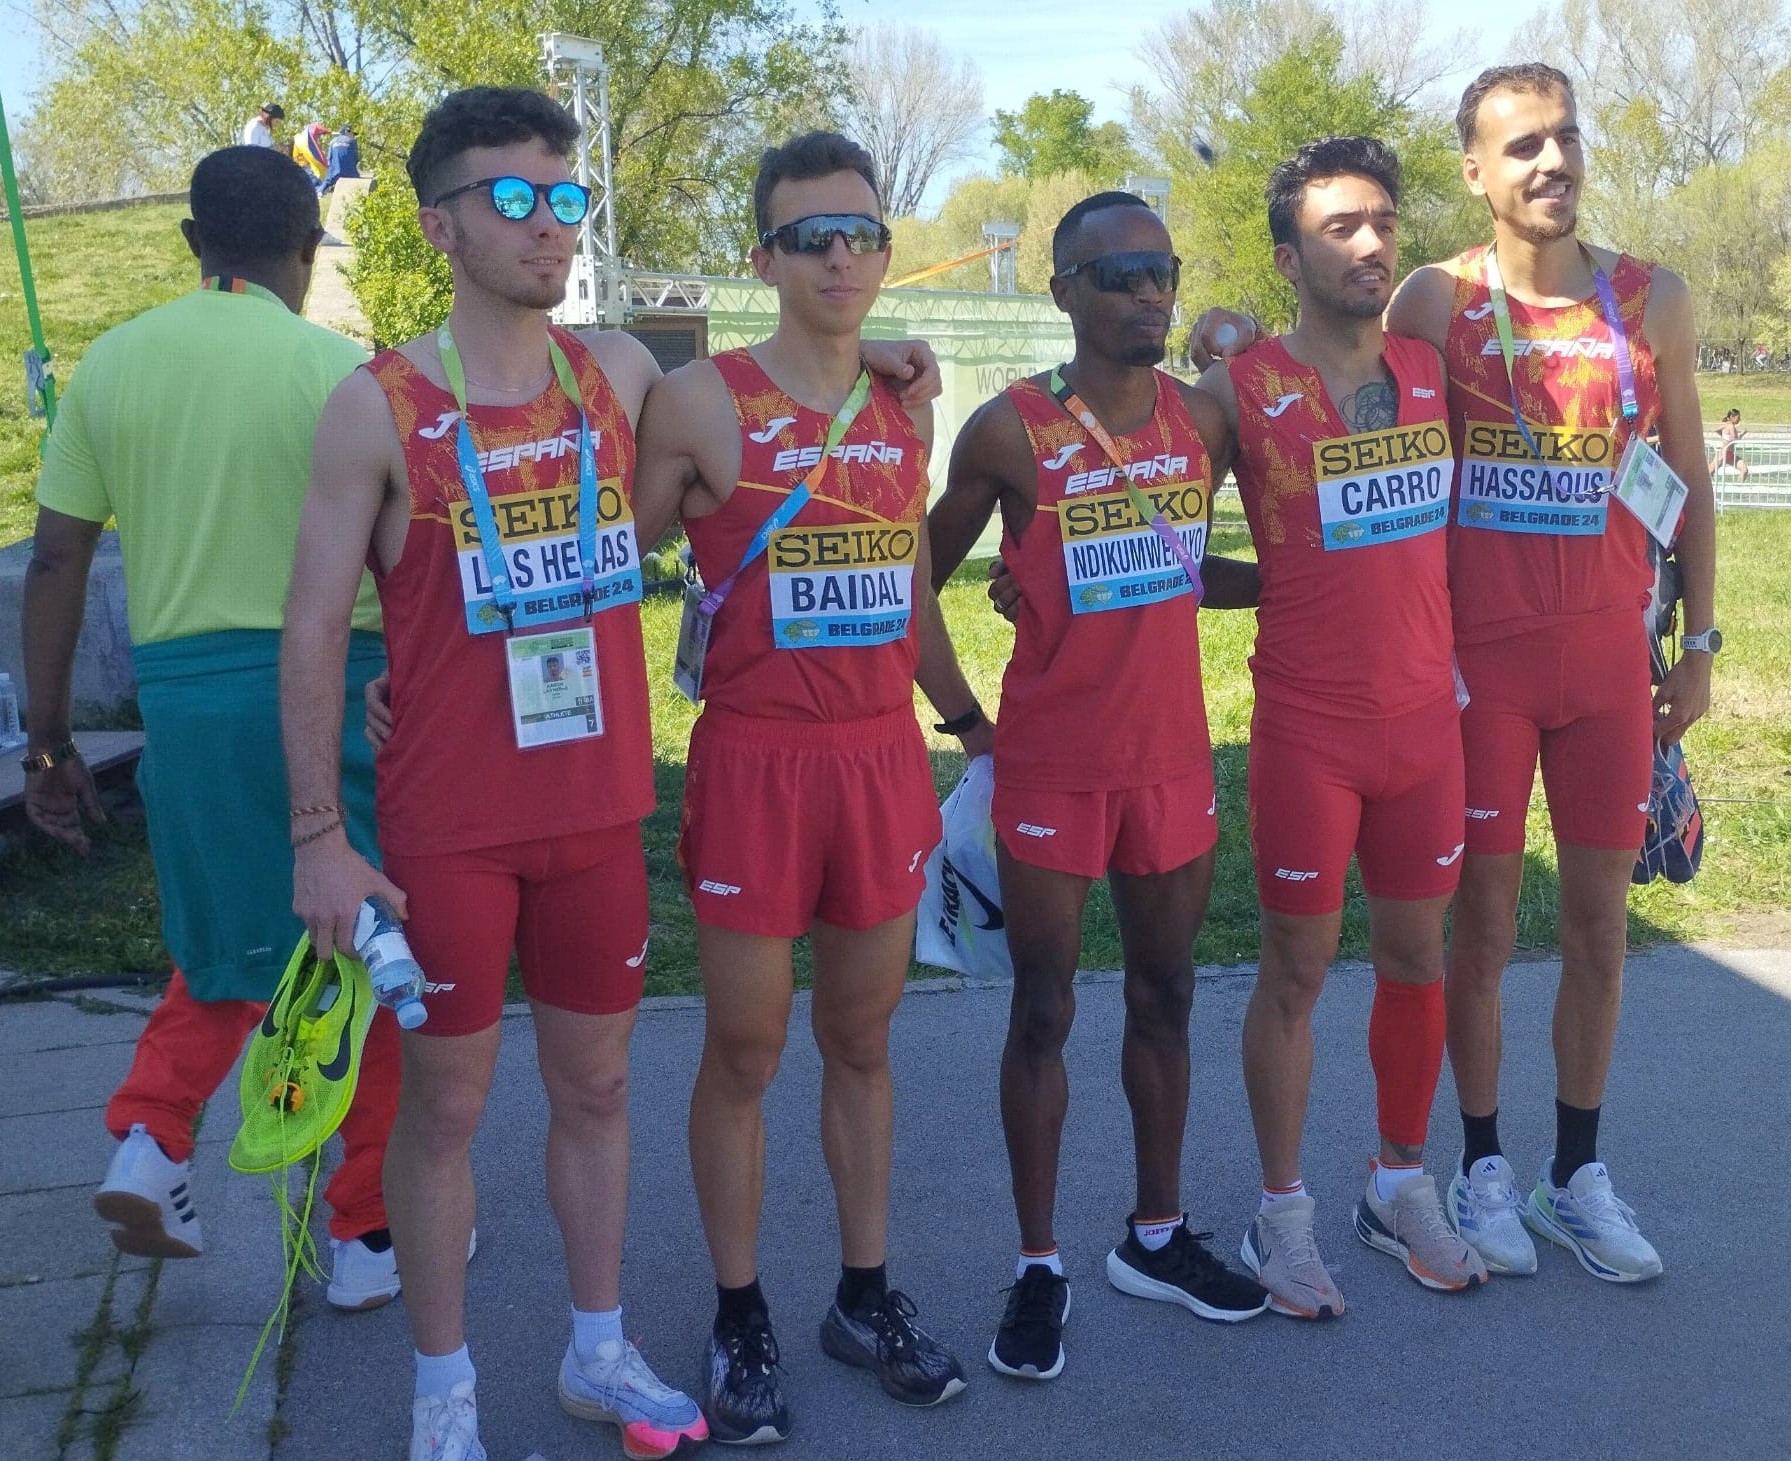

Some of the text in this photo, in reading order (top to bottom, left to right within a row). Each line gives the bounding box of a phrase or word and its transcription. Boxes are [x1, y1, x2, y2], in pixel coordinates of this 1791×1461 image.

[976, 366, 1037, 394] WOR
[1320, 427, 1447, 476] SEIKO
[1470, 427, 1609, 463] SEIKO
[1341, 466, 1441, 516] CARRO
[1469, 464, 1604, 504] HASSAOUS
[459, 486, 623, 545] SEIKO
[1370, 510, 1434, 535] BELGRADE
[1500, 509, 1580, 526] BELGRADE
[1581, 514, 1600, 526] 24
[472, 530, 630, 595] LS HEAS
[775, 529, 915, 568] SEIKO
[524, 578, 635, 615] BELGRDE 24
[791, 571, 904, 612] BAIDAL
[1119, 574, 1185, 598] BELGRADE
[828, 620, 895, 637] BELGRADE
[1465, 807, 1500, 820] ESP
[1016, 822, 1057, 838] ESP
[699, 879, 741, 896] ESP
[1274, 867, 1319, 881] ESP
[424, 981, 456, 994] SP
